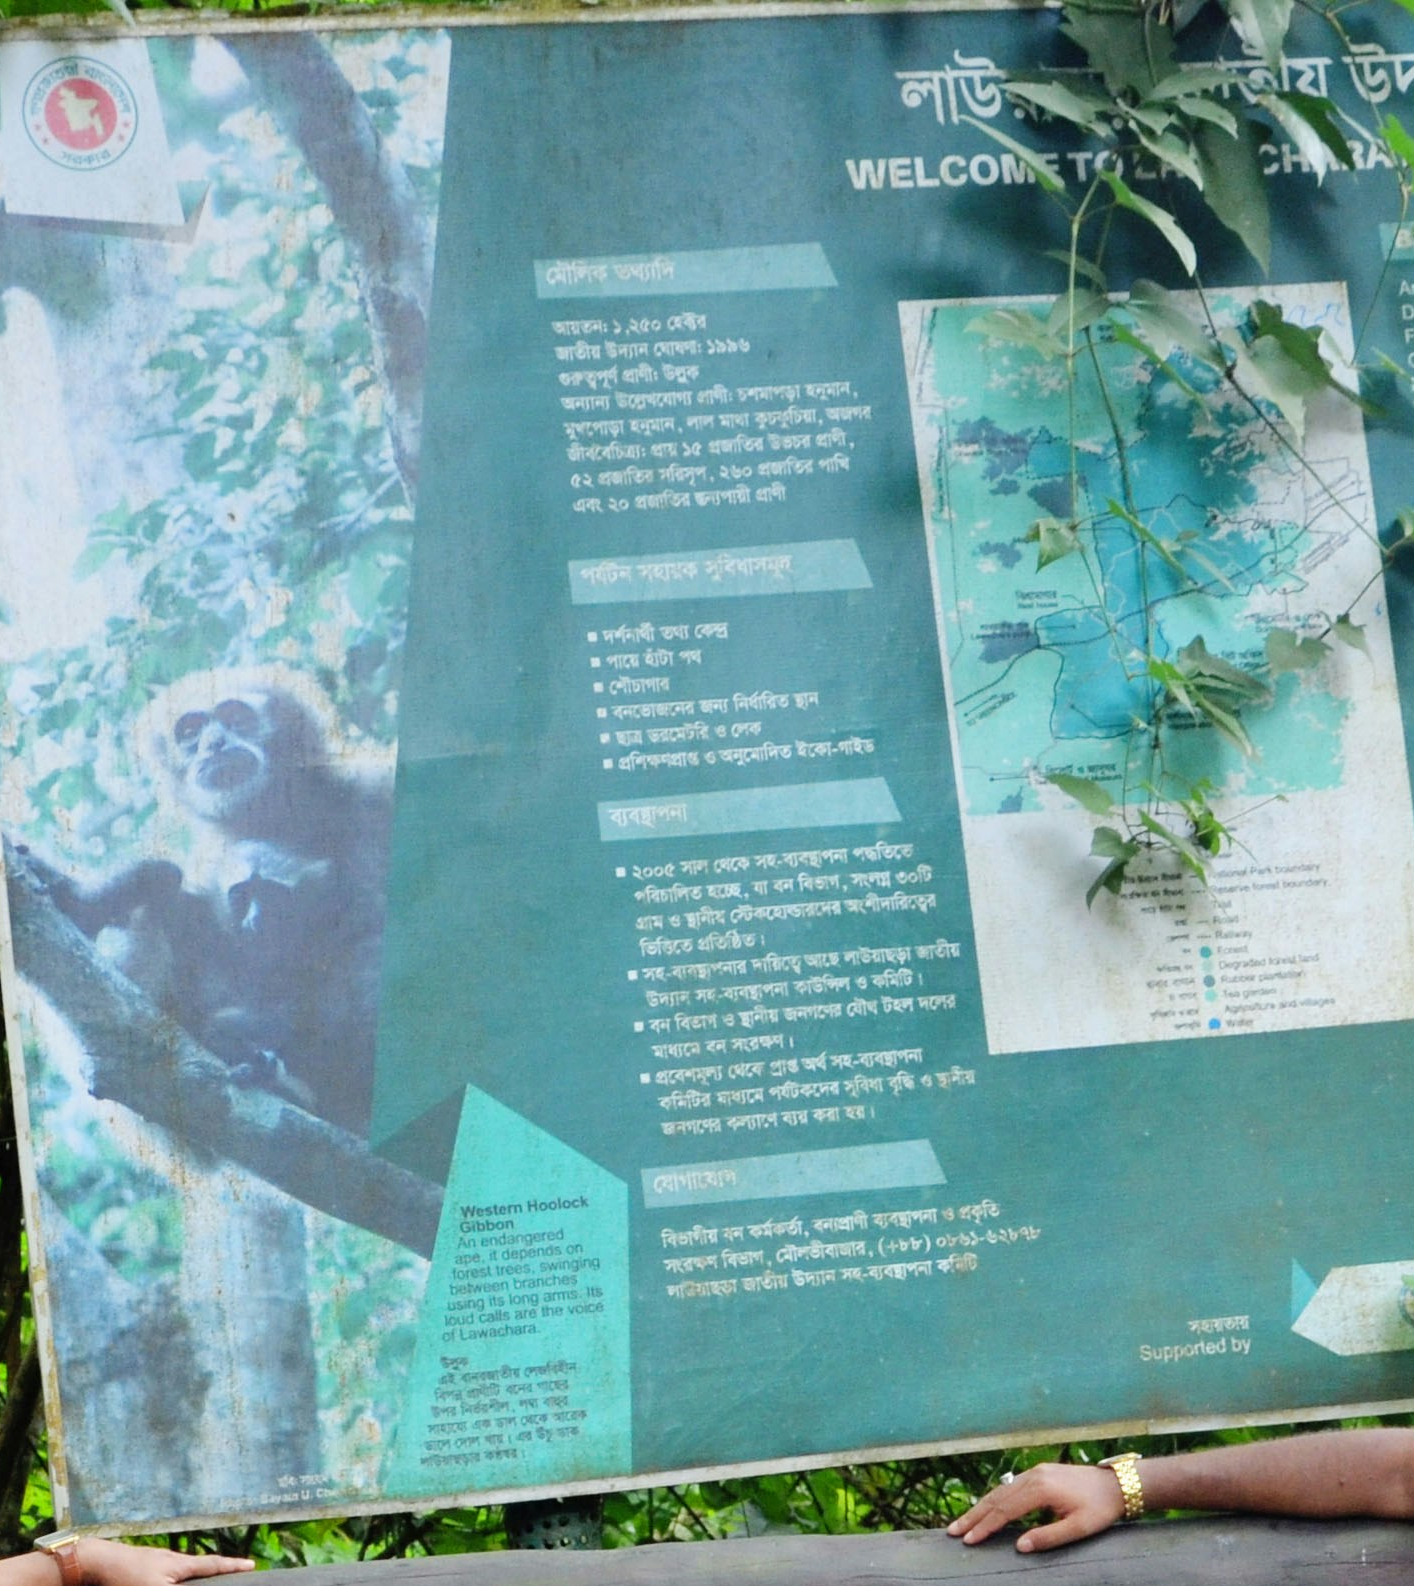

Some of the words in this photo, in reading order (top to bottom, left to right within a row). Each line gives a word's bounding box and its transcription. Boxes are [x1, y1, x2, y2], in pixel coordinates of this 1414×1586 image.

[847, 153, 1059, 190] WELCOME
[460, 1204, 523, 1218] Western
[527, 1196, 589, 1212] Hoolock
[460, 1220, 514, 1233] Gibbon
[457, 1237, 476, 1249] An
[480, 1228, 564, 1247] endangered
[501, 1245, 562, 1261] depends
[566, 1244, 583, 1255] on
[452, 1264, 492, 1280] forest
[540, 1257, 600, 1272] swinging
[449, 1281, 509, 1296] between
[513, 1271, 578, 1289] branches
[447, 1298, 485, 1311] using
[489, 1295, 505, 1307] its
[508, 1293, 539, 1306] long
[586, 1286, 603, 1297] Its
[444, 1313, 474, 1326] loud
[478, 1309, 510, 1323] calls
[515, 1308, 537, 1319] are
[541, 1305, 564, 1317] the
[567, 1302, 604, 1314] voice
[442, 1329, 455, 1342] of
[1140, 1339, 1226, 1362] Supported
[1231, 1336, 1251, 1355] by
